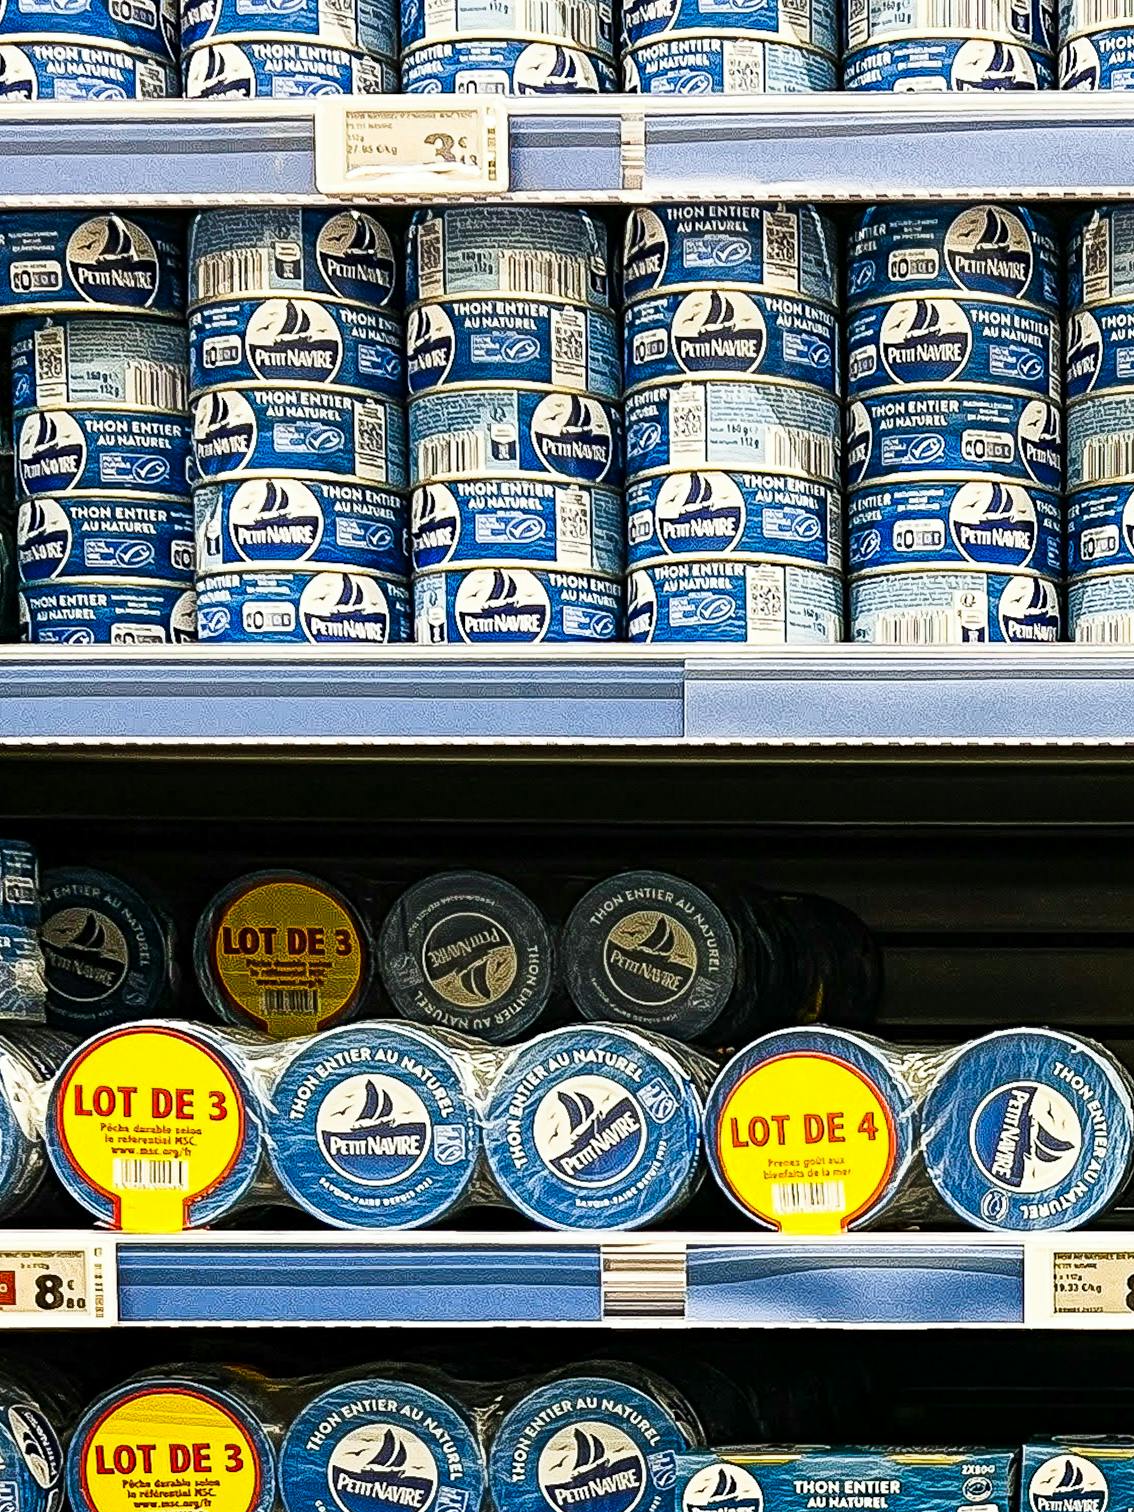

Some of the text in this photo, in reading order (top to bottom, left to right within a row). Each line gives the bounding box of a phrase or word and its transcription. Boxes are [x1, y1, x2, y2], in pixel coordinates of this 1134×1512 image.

[85, 420, 181, 436] THON ENTIER
[97, 435, 171, 449] AU NATUREL
[223, 928, 352, 954] LOT DE 3
[290, 1048, 454, 1120] THON ENTIER AU NATUREL
[74, 1085, 227, 1120] LOT DE 3
[731, 1112, 878, 1146] LOT DE 4
[95, 1444, 244, 1475] LOT DE 3
[794, 1480, 900, 1494] THON ENTIER
[808, 1496, 887, 1508] AU NATUREL
